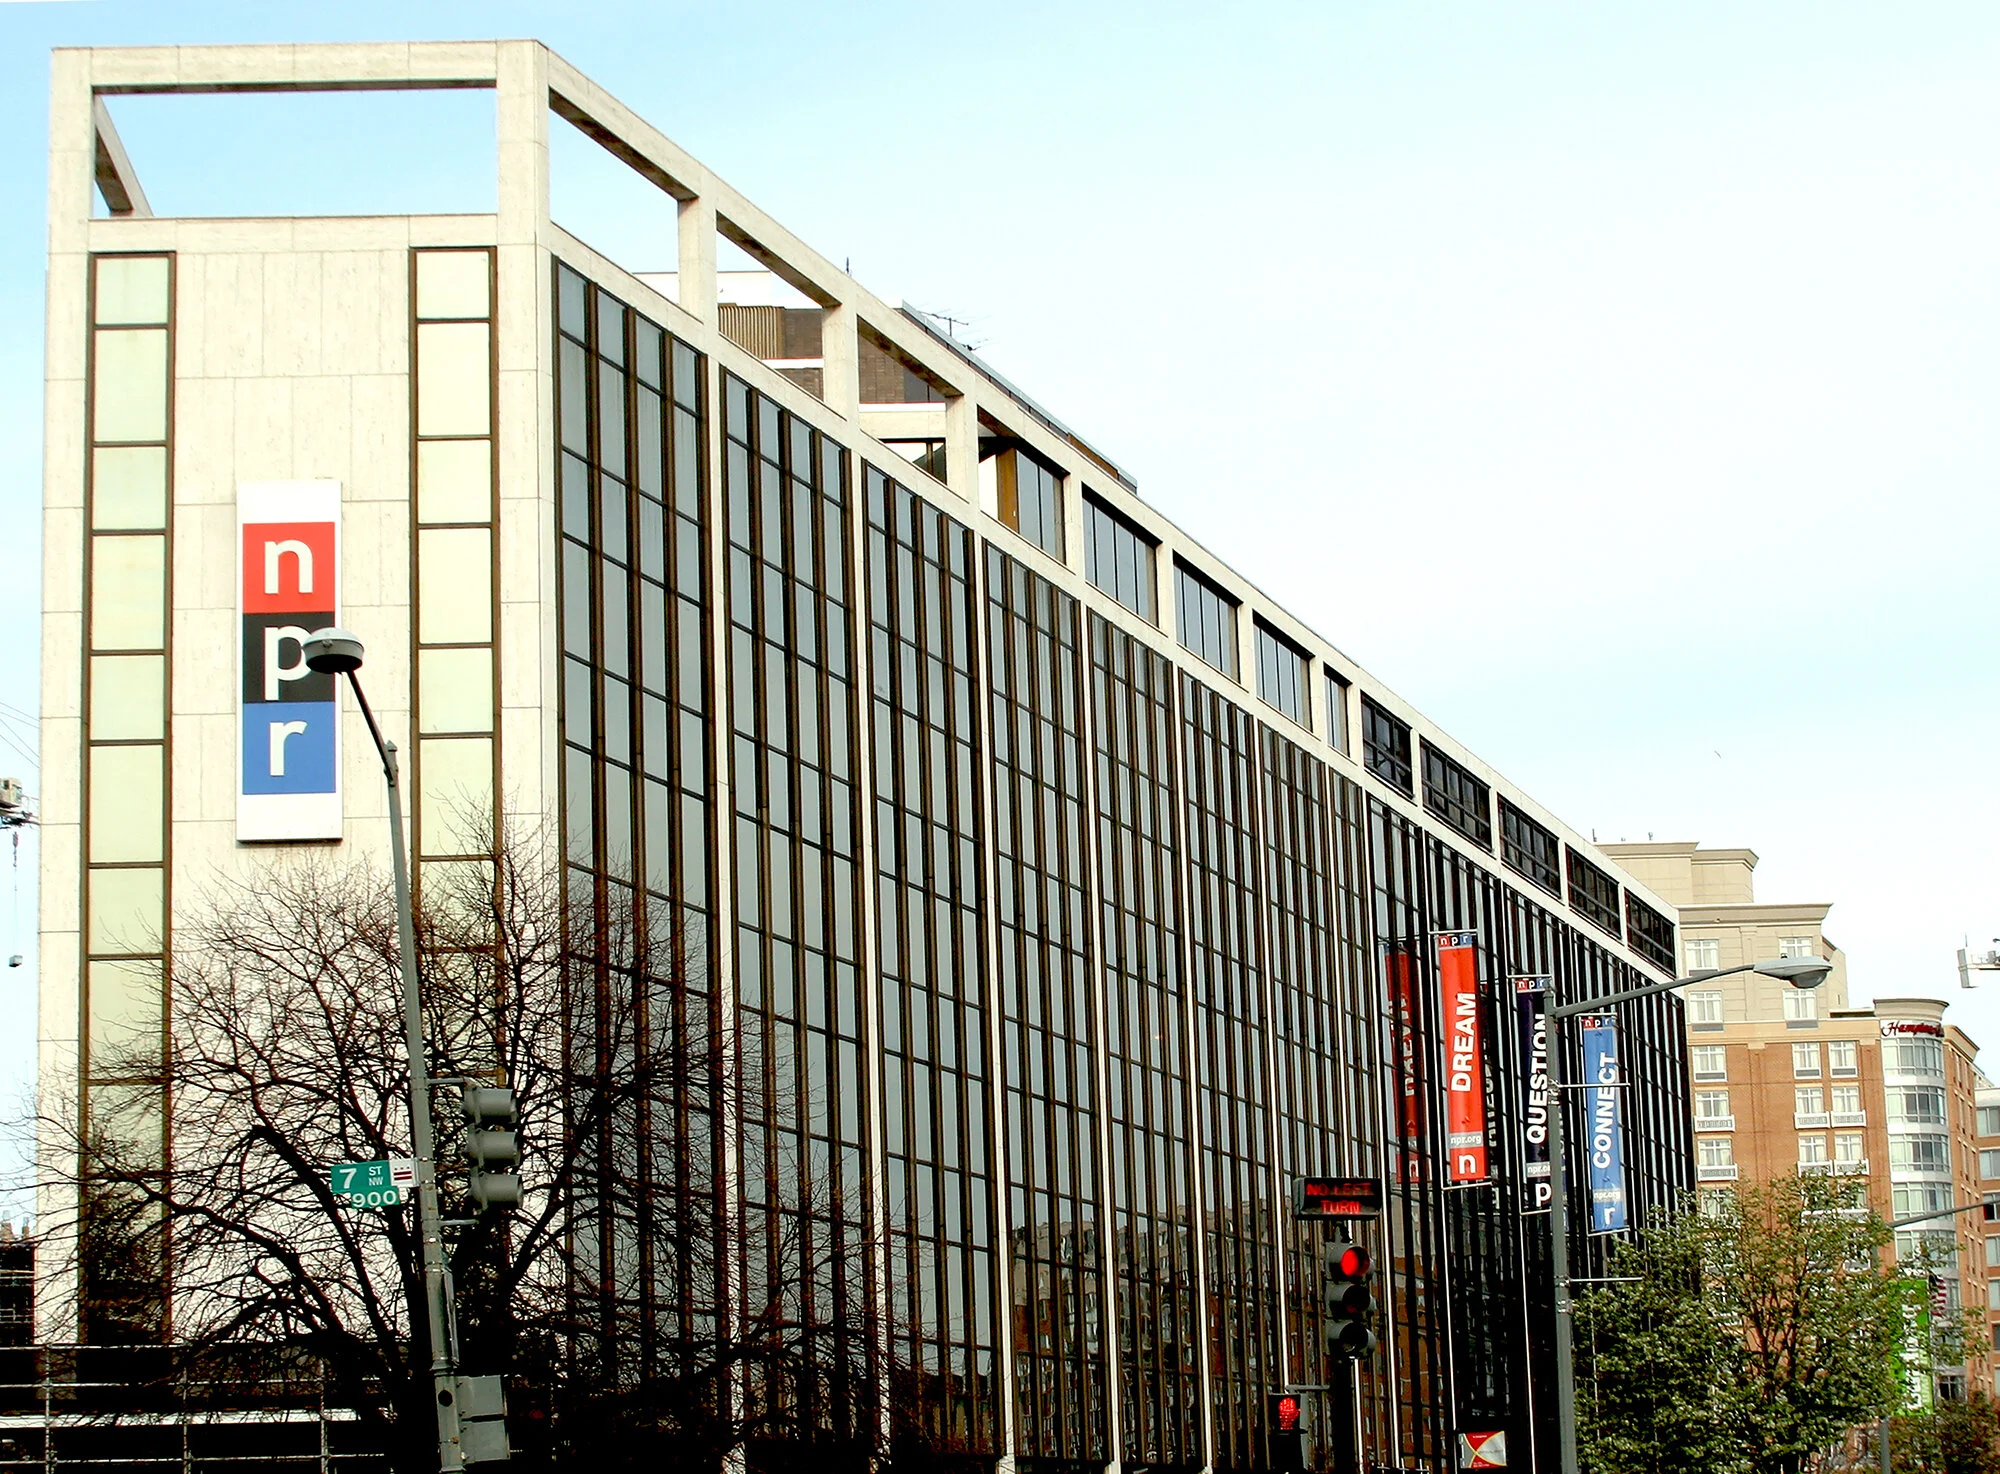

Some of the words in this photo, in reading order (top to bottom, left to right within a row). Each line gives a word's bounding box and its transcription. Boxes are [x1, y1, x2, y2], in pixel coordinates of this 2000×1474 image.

[264, 539, 314, 776] npr
[1440, 936, 1469, 947] npr
[1518, 980, 1545, 989] npr
[1585, 1018, 1609, 1028] npr
[1451, 992, 1476, 1092] DREAM
[1526, 1013, 1548, 1144] QUESTION
[1593, 1052, 1617, 1169] CONNECT
[1450, 1135, 1482, 1145] npr.org
[1459, 1154, 1476, 1174] n
[339, 1168, 357, 1189] 7
[369, 1166, 383, 1176] ST
[368, 1177, 383, 1186] NW
[1305, 1183, 1329, 1196] NO
[1535, 1183, 1552, 1208] p
[352, 1190, 397, 1208] 900
[1321, 1200, 1361, 1214] TURN
